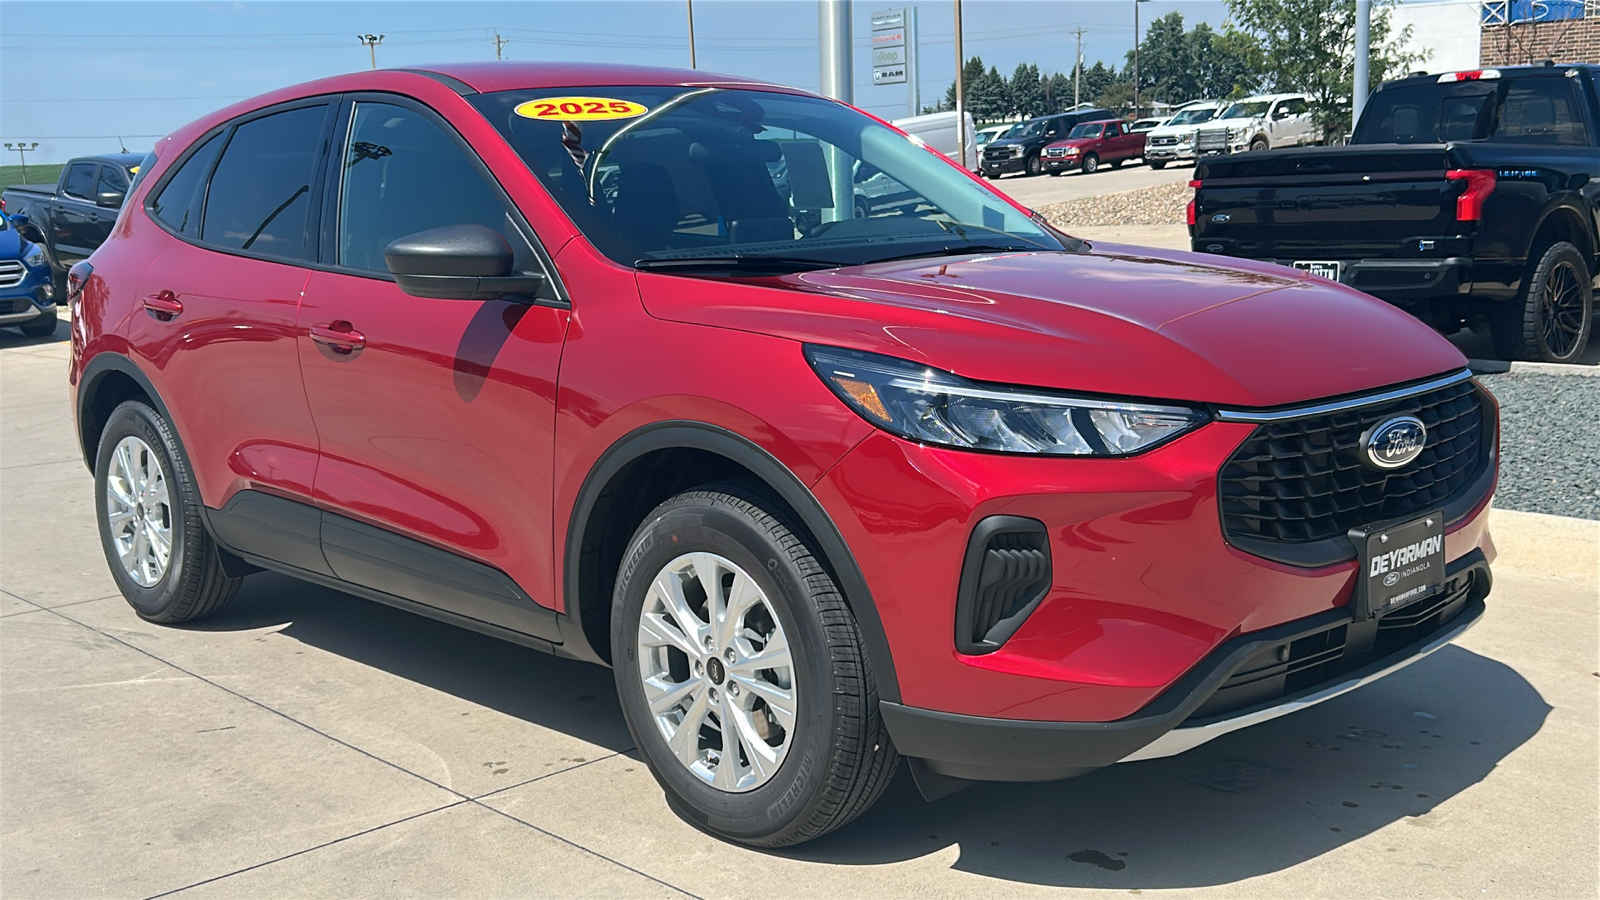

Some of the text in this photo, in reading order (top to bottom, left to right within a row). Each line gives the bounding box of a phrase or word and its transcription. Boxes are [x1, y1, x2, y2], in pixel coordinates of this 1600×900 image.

[878, 51, 898, 62] Jeep
[881, 70, 904, 78] RAM
[534, 102, 632, 116] 2025
[1386, 428, 1418, 457] Ford
[1370, 534, 1442, 577] DEYARMAN
[617, 534, 653, 602] MICHELIN
[1401, 562, 1431, 578] INDIANOLA
[768, 754, 813, 820] MICHELIN
